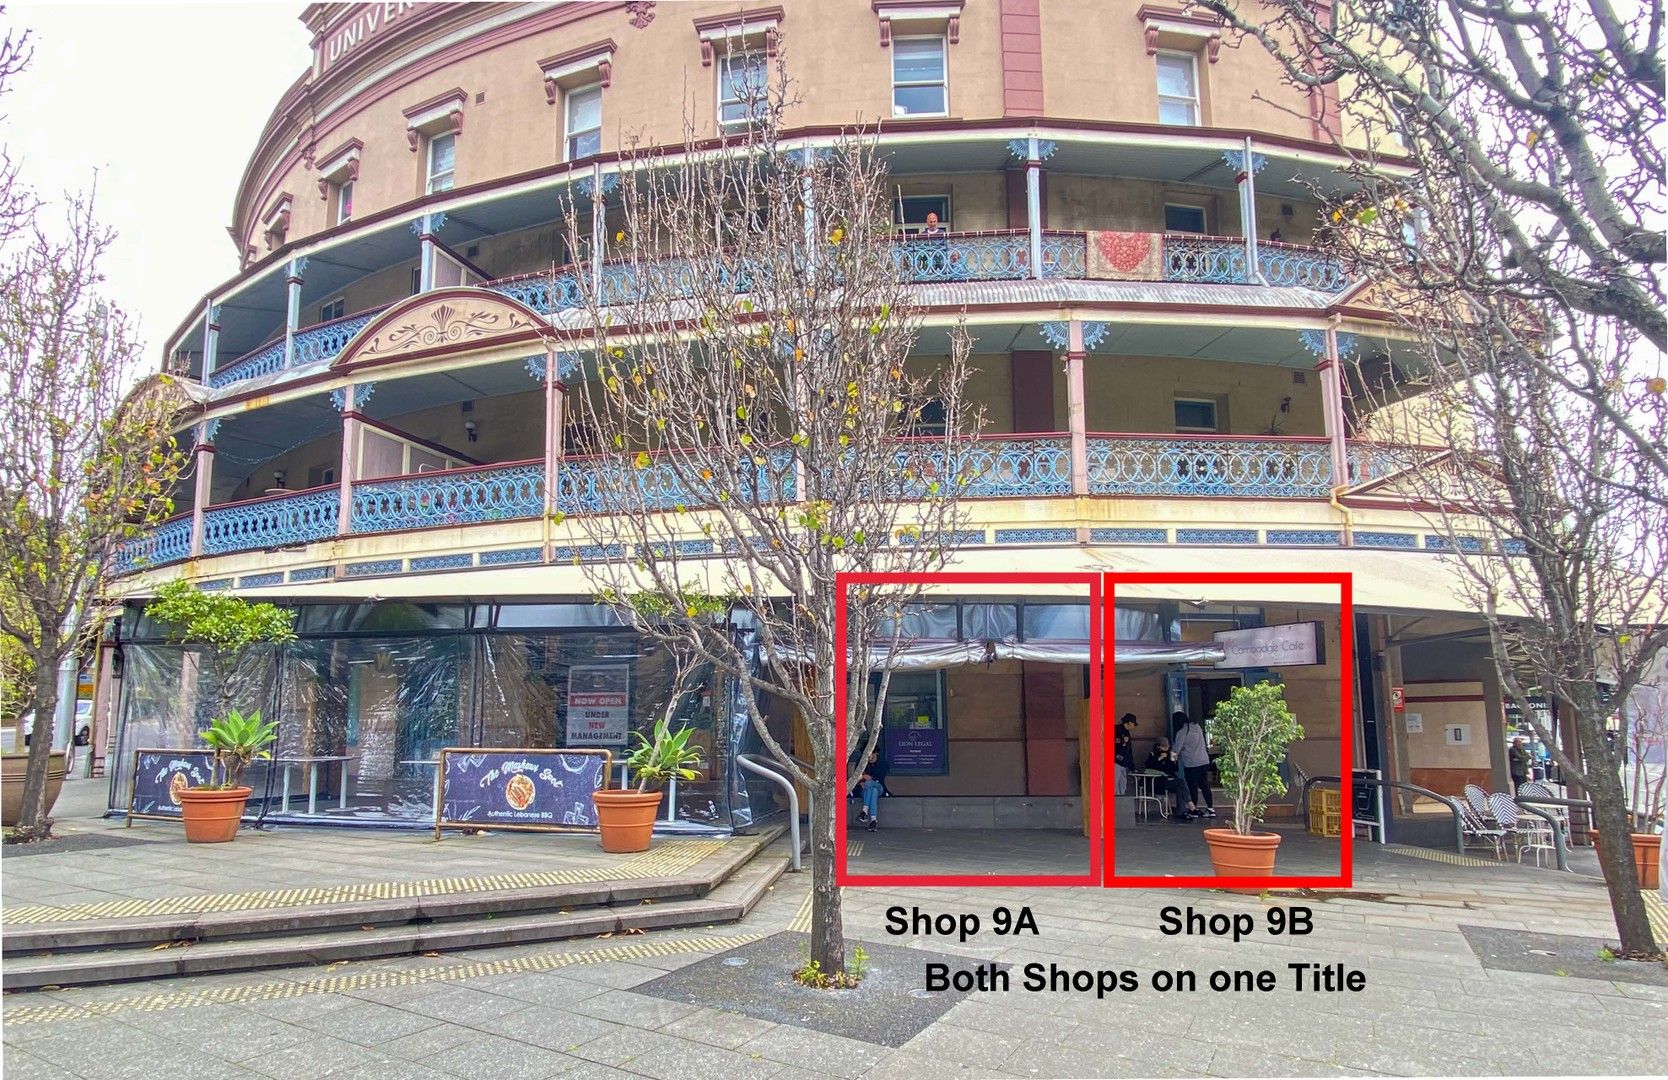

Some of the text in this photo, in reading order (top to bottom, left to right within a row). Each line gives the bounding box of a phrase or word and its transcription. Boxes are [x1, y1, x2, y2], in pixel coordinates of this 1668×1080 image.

[574, 697, 622, 705] NOW OPEN
[588, 721, 606, 729] NEW
[570, 732, 622, 740] MANAGEMENT
[479, 769, 500, 788] The
[539, 768, 564, 788] Spot
[487, 810, 513, 818] Authentic
[541, 811, 553, 819] BBQ
